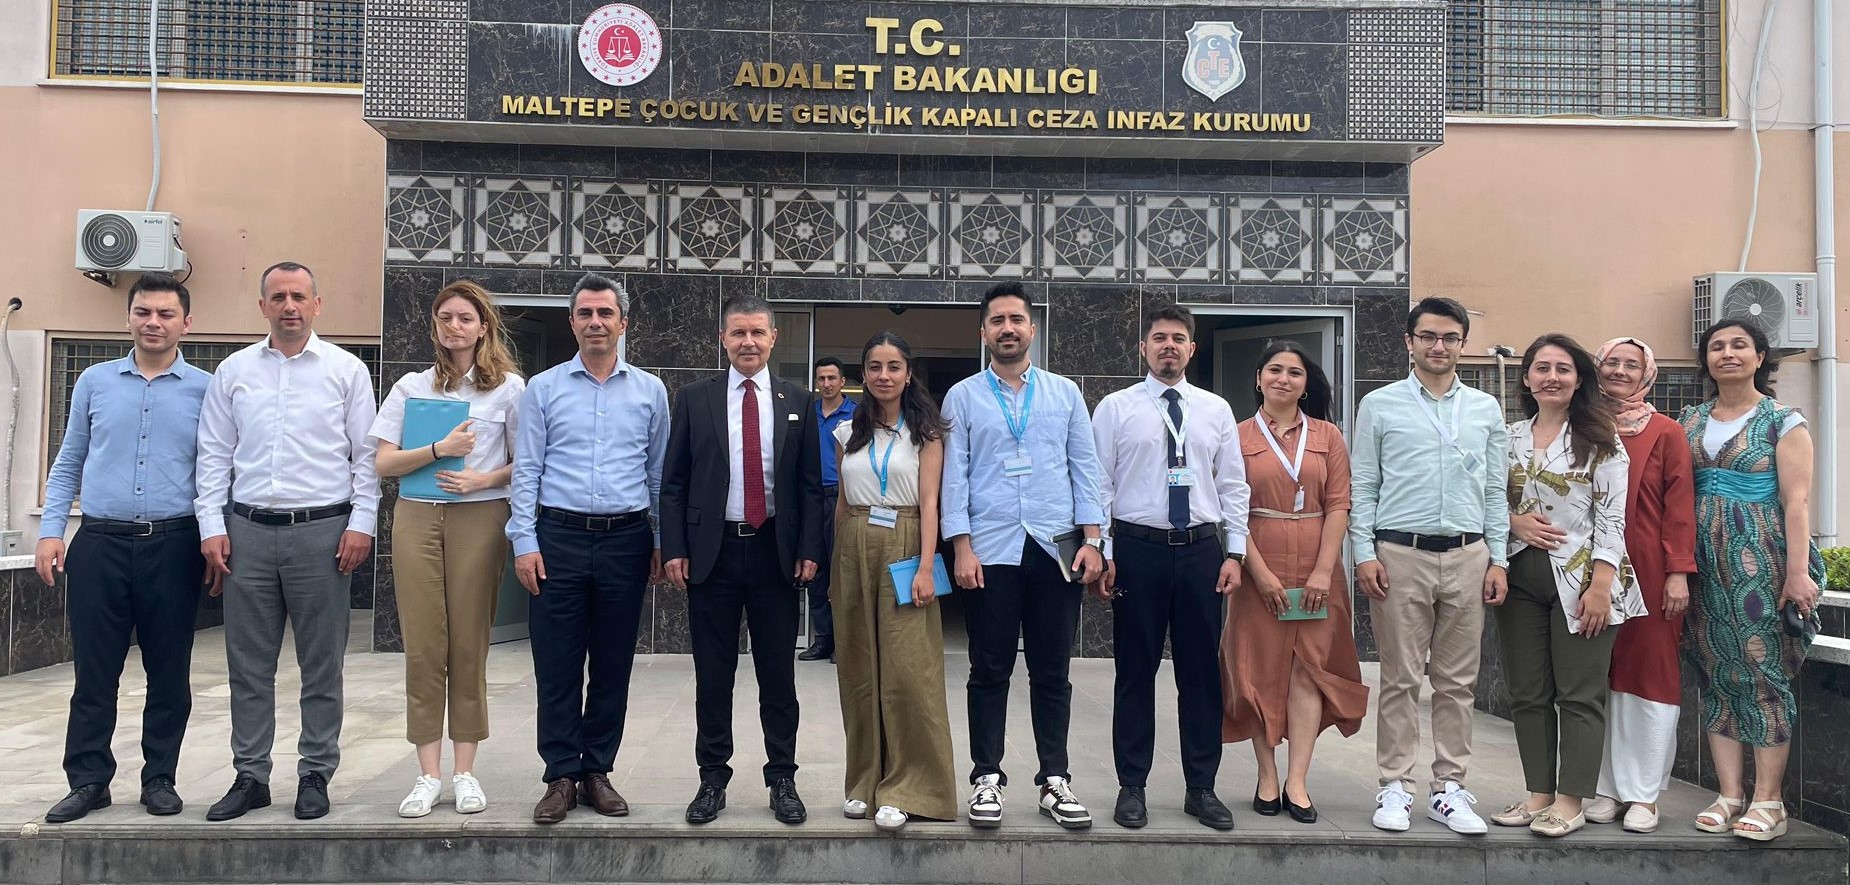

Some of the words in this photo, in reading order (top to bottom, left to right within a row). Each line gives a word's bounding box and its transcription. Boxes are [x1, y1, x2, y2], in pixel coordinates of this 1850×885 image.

[865, 17, 961, 56] T.C.
[733, 61, 882, 91] ADALET
[502, 95, 631, 118] MALTEPE
[639, 100, 739, 123] ÇOCUK
[747, 104, 784, 124] VE
[792, 102, 913, 129] GENÇLİK
[921, 107, 1018, 127] KAPALI
[1026, 109, 1099, 129] CEZA
[1193, 112, 1312, 132] KURUMU
